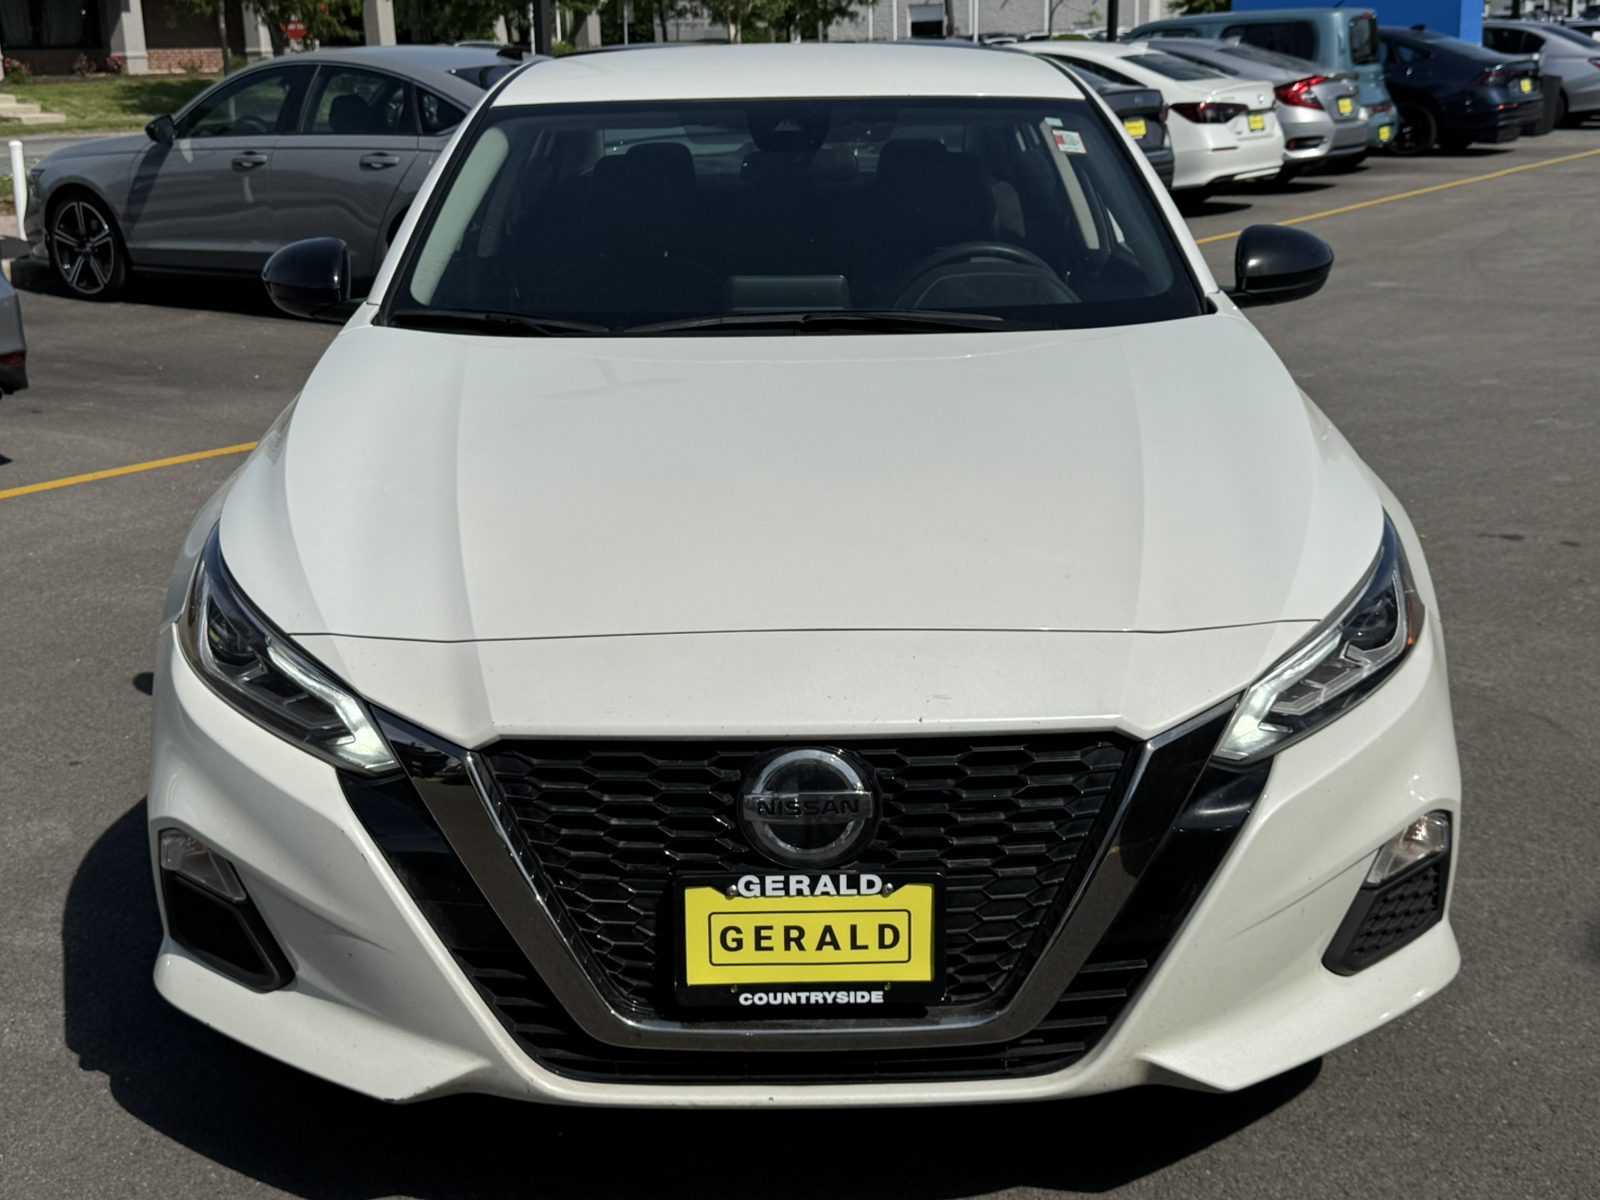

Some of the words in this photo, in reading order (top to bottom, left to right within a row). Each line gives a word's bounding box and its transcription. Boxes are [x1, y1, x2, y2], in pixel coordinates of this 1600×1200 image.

[756, 800, 859, 816] NISSAN
[737, 874, 882, 897] GERALD
[719, 923, 901, 952] GERALD
[738, 991, 884, 1005] COUNTRYSIDE
